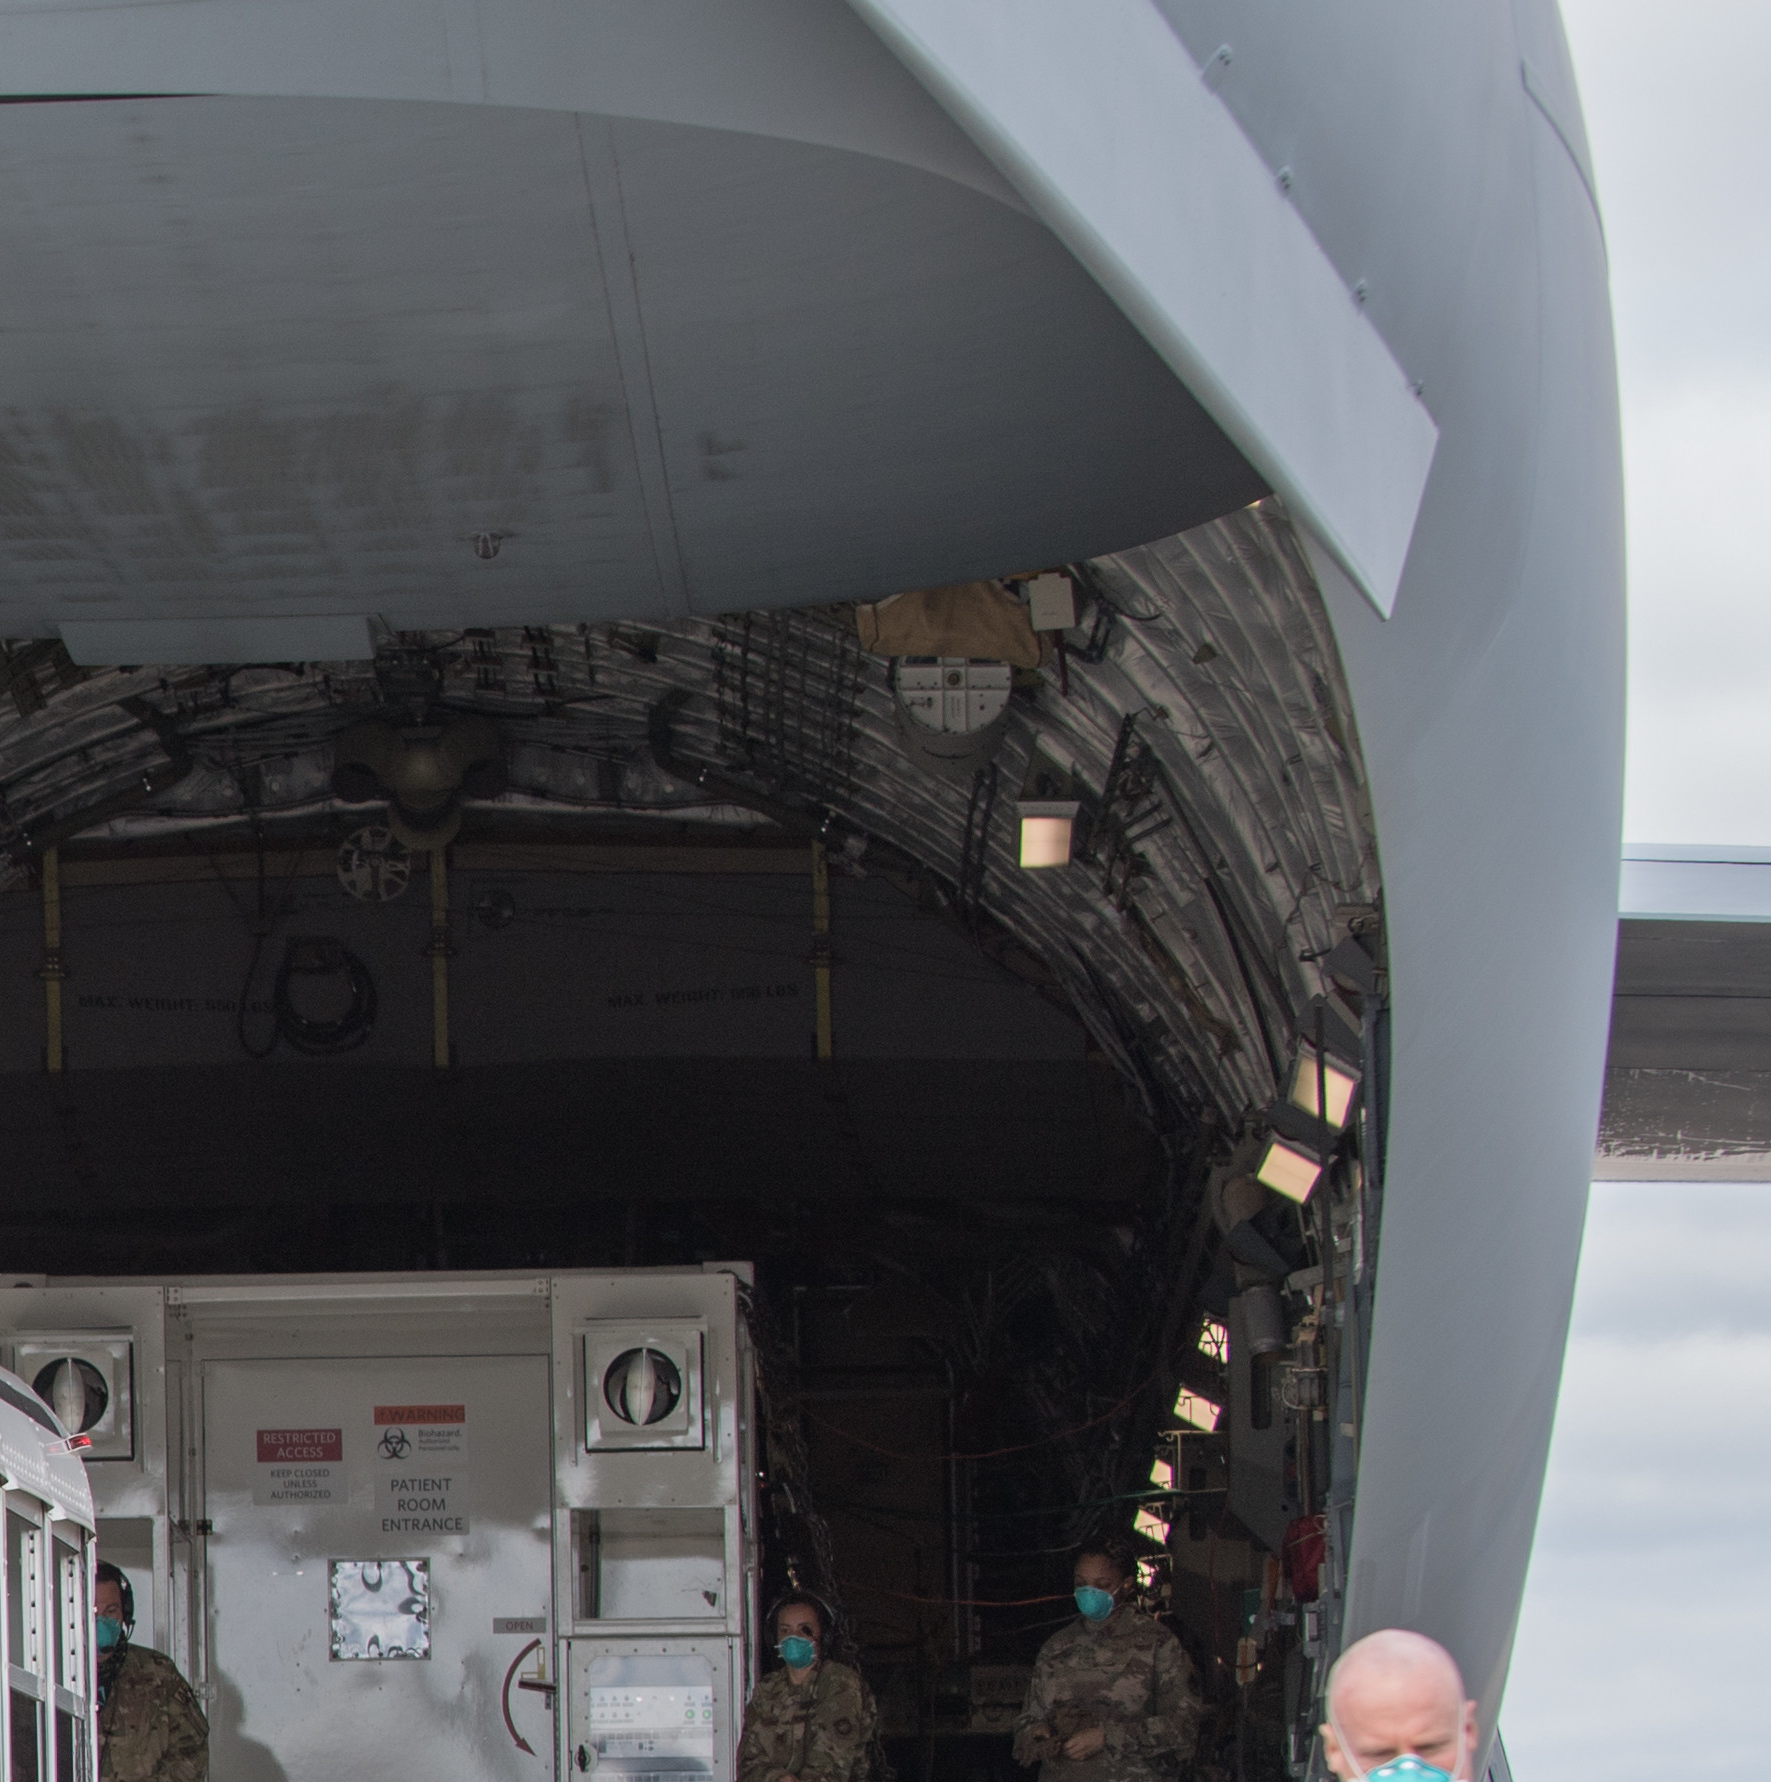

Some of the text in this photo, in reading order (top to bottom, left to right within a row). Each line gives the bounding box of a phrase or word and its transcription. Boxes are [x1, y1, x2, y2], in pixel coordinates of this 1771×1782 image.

[389, 1408, 464, 1422] WARNING
[263, 1432, 336, 1445] RESTRICTED
[276, 1447, 324, 1459] ACCESS
[270, 1469, 330, 1478] KEEP CLOSED
[283, 1480, 318, 1489] UNLESS
[390, 1478, 452, 1492] PATIENT
[270, 1490, 331, 1499] AUTHORIZED
[397, 1498, 446, 1512] ROOM
[382, 1517, 463, 1532] ENTRANCE
[505, 1621, 534, 1631] OPEN
